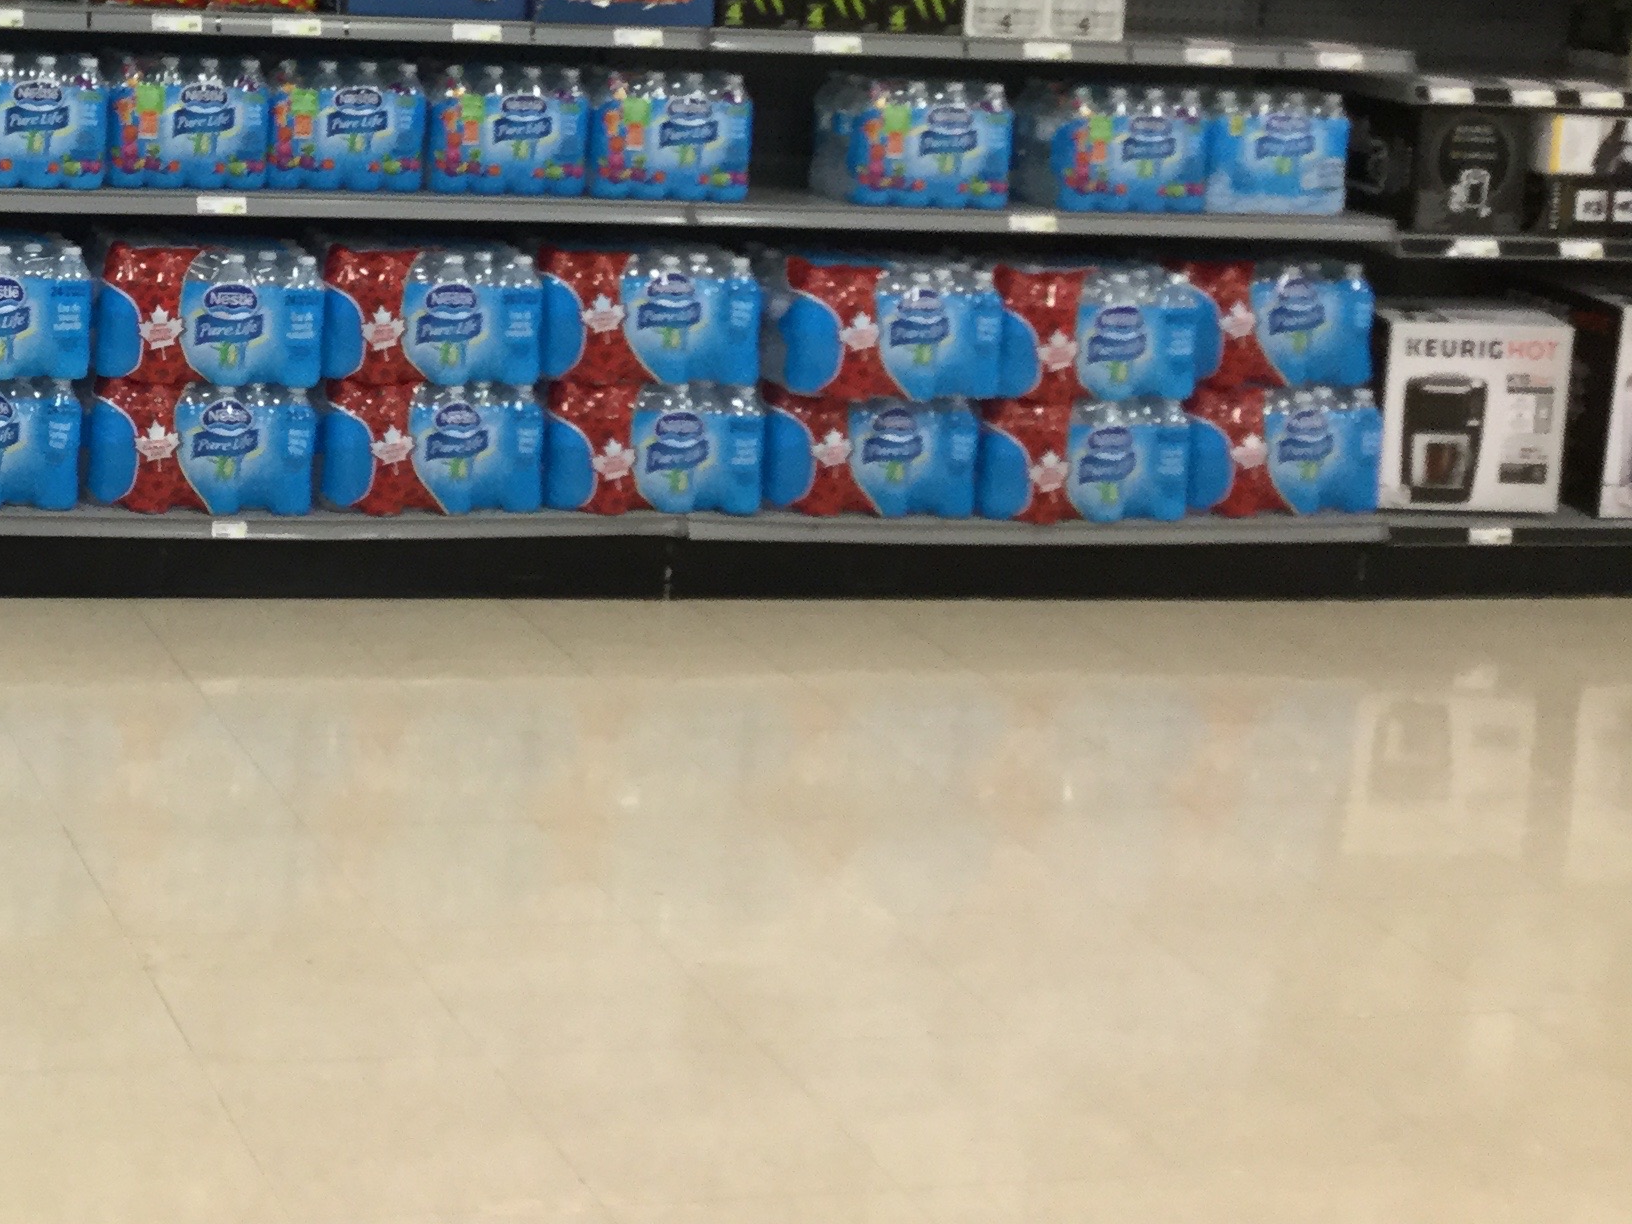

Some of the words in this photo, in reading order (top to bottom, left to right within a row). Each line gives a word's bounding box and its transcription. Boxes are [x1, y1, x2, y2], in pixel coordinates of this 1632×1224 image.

[1, 313, 26, 330] Life
[199, 321, 233, 339] Pure
[234, 317, 260, 337] Life
[1404, 338, 1504, 360] KEURIG
[1506, 340, 1561, 361] HOT
